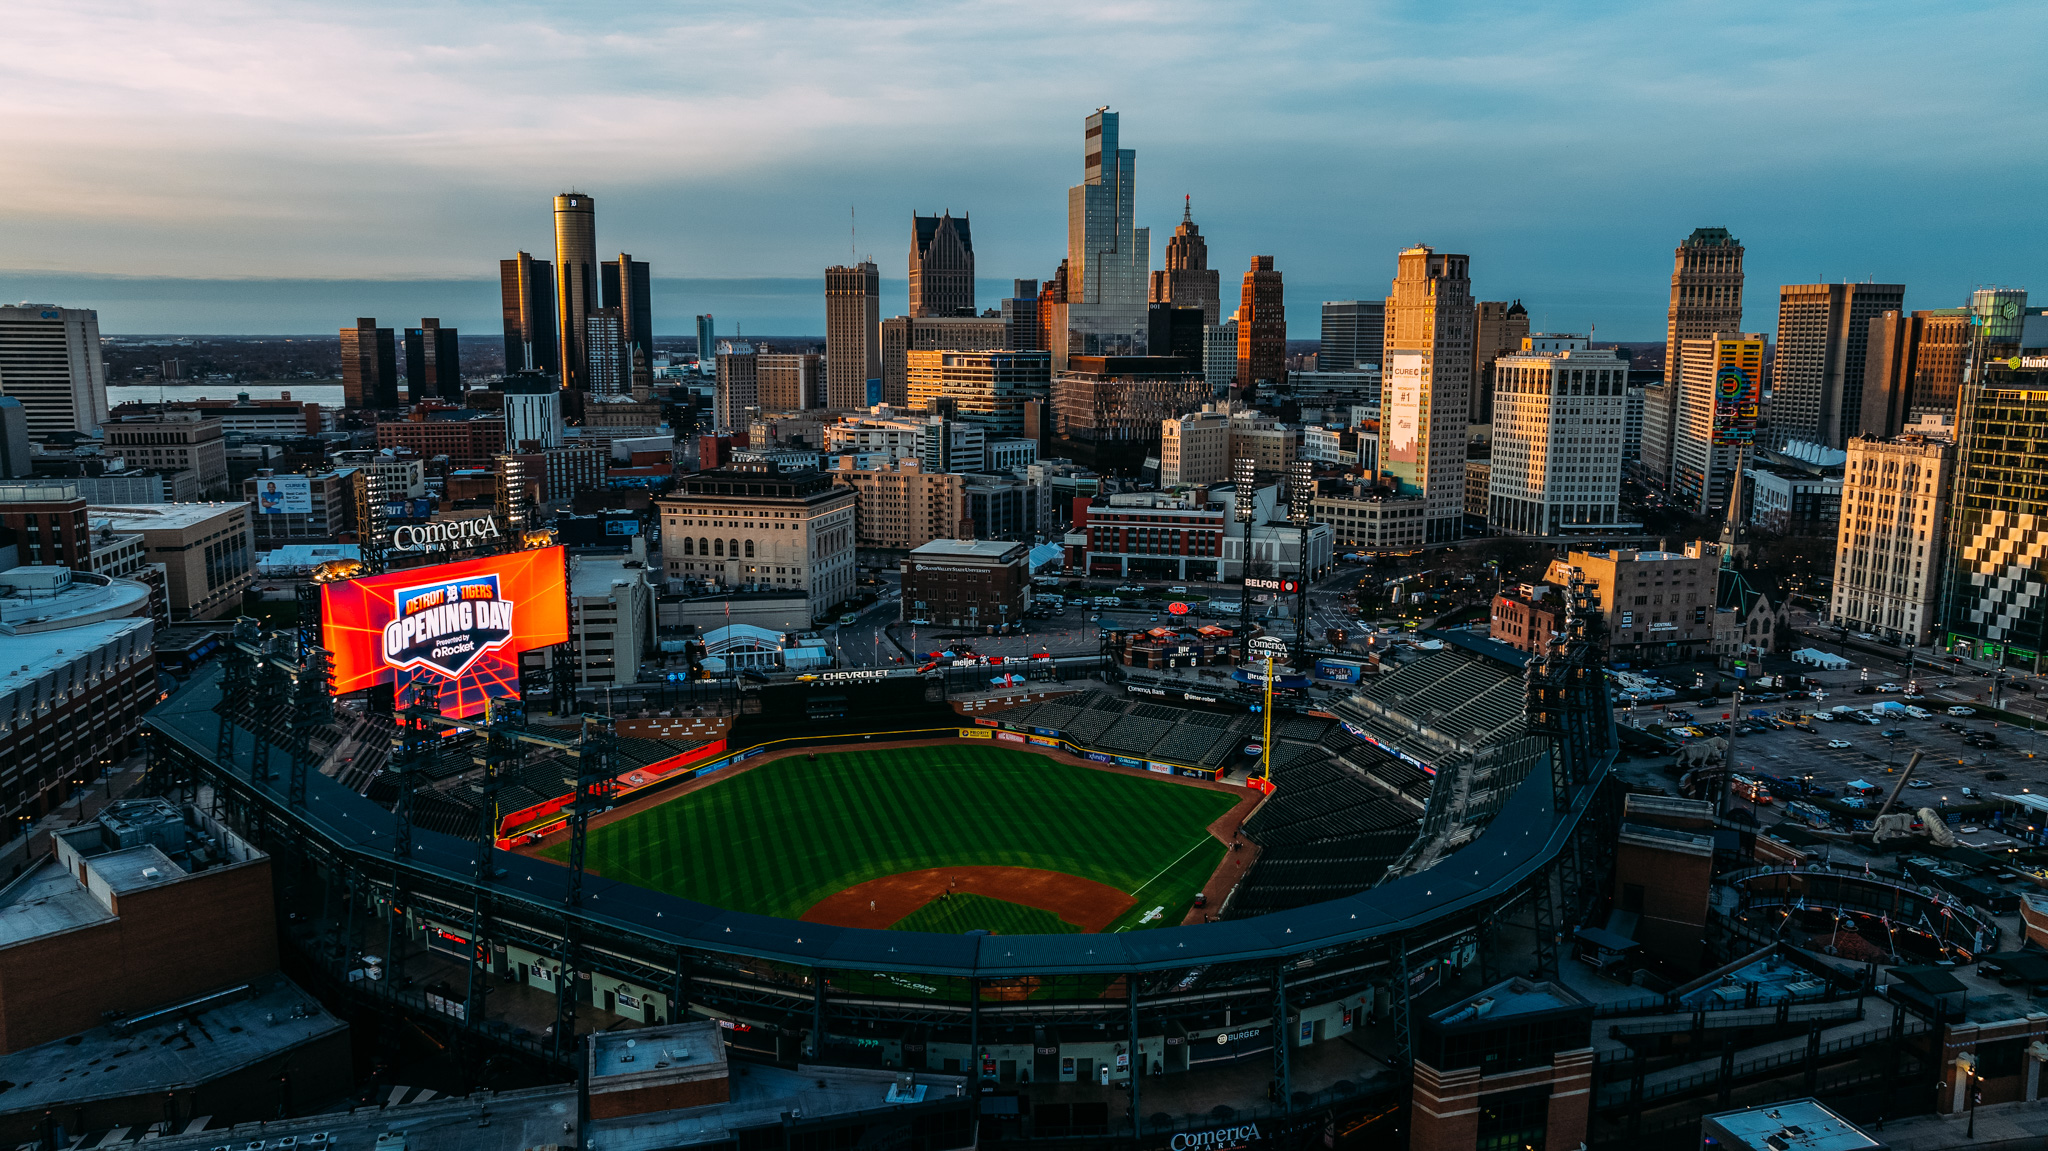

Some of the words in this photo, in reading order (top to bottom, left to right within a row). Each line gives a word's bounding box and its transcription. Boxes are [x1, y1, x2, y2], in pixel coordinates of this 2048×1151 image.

[1401, 392, 1410, 402] #1
[425, 538, 474, 554] PARK
[1245, 578, 1279, 589] BELFOR
[406, 589, 444, 615] DETROIT
[460, 584, 493, 600] TIGERS
[388, 601, 473, 656] OPENING
[476, 600, 512, 630] DAY
[436, 634, 462, 647] Presented
[462, 634, 470, 642] by
[441, 642, 474, 658] Rocket
[1248, 649, 1288, 658] LANING
[952, 658, 976, 668] meijer
[823, 670, 889, 680] CHEVROLET
[1089, 753, 1106, 762] xfinity
[1228, 1030, 1260, 1041] BURGER
[1194, 1140, 1236, 1151] PARK
